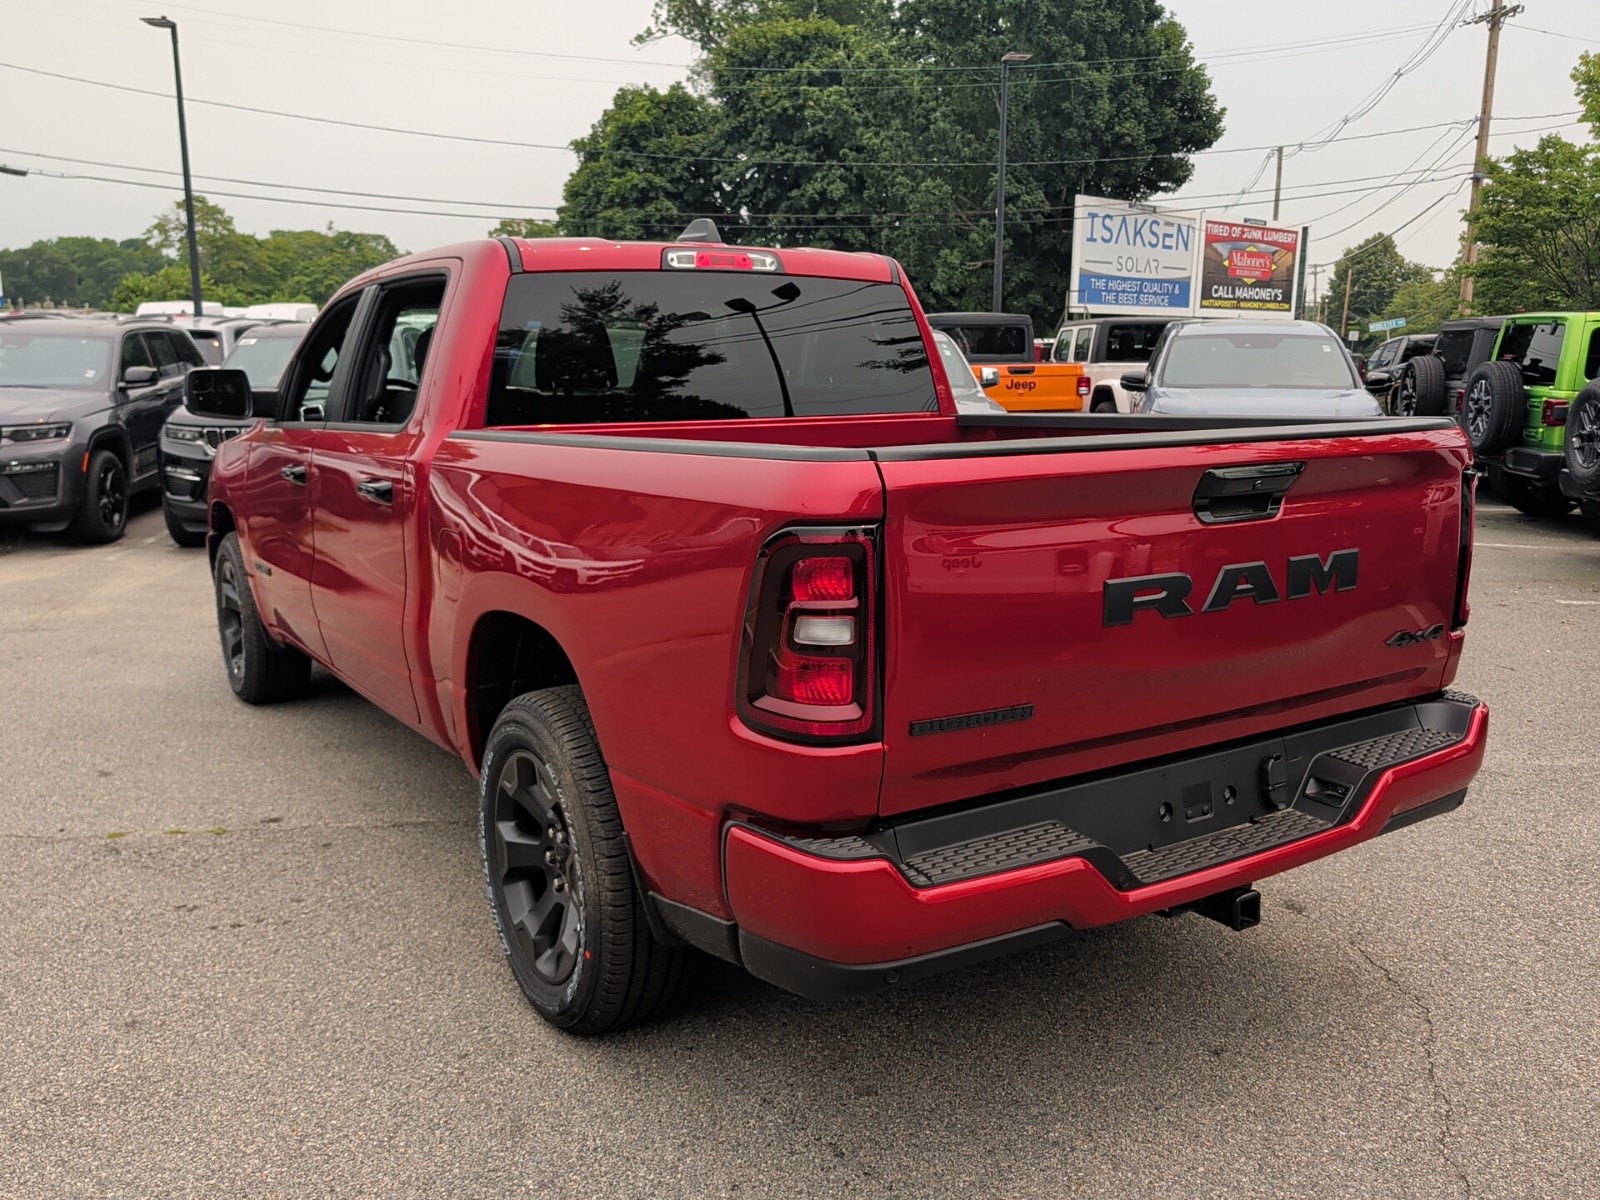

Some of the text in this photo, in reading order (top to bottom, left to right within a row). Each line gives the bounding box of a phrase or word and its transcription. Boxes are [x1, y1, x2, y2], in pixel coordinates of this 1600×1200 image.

[1086, 212, 1191, 252] ISAKSEN
[1206, 224, 1296, 244] TIRED OF JUNK LUMBER?
[1116, 255, 1159, 274] SOLAR
[1231, 252, 1270, 268] Mahoney's
[1091, 278, 1180, 294] THE HIGHEST QUALITY &
[1211, 284, 1283, 301] CALL MAHONEY'S
[1101, 292, 1169, 306] THE BEST SERVICE
[1005, 379, 1036, 392] Jeep
[1103, 547, 1360, 628] RAM
